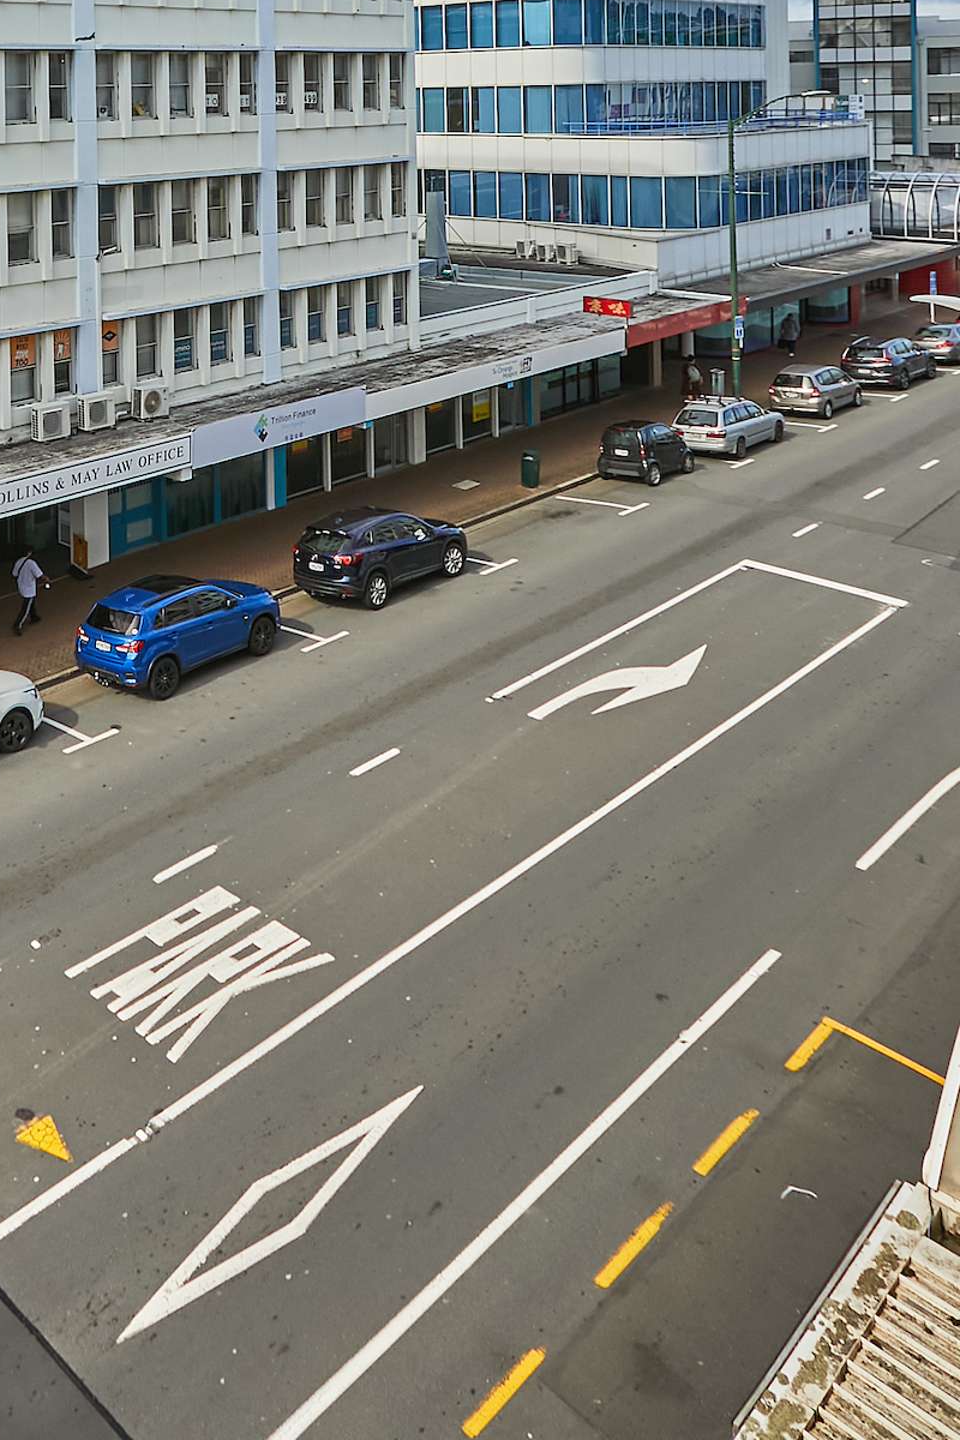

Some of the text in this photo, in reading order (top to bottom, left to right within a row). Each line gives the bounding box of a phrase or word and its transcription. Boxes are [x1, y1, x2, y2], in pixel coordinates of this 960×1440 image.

[293, 408, 317, 419] Finance
[55, 477, 65, 491] &
[71, 467, 101, 487] MAY
[106, 459, 134, 477] LAW
[138, 446, 185, 468] OFFICE
[65, 885, 336, 1064] PARK
